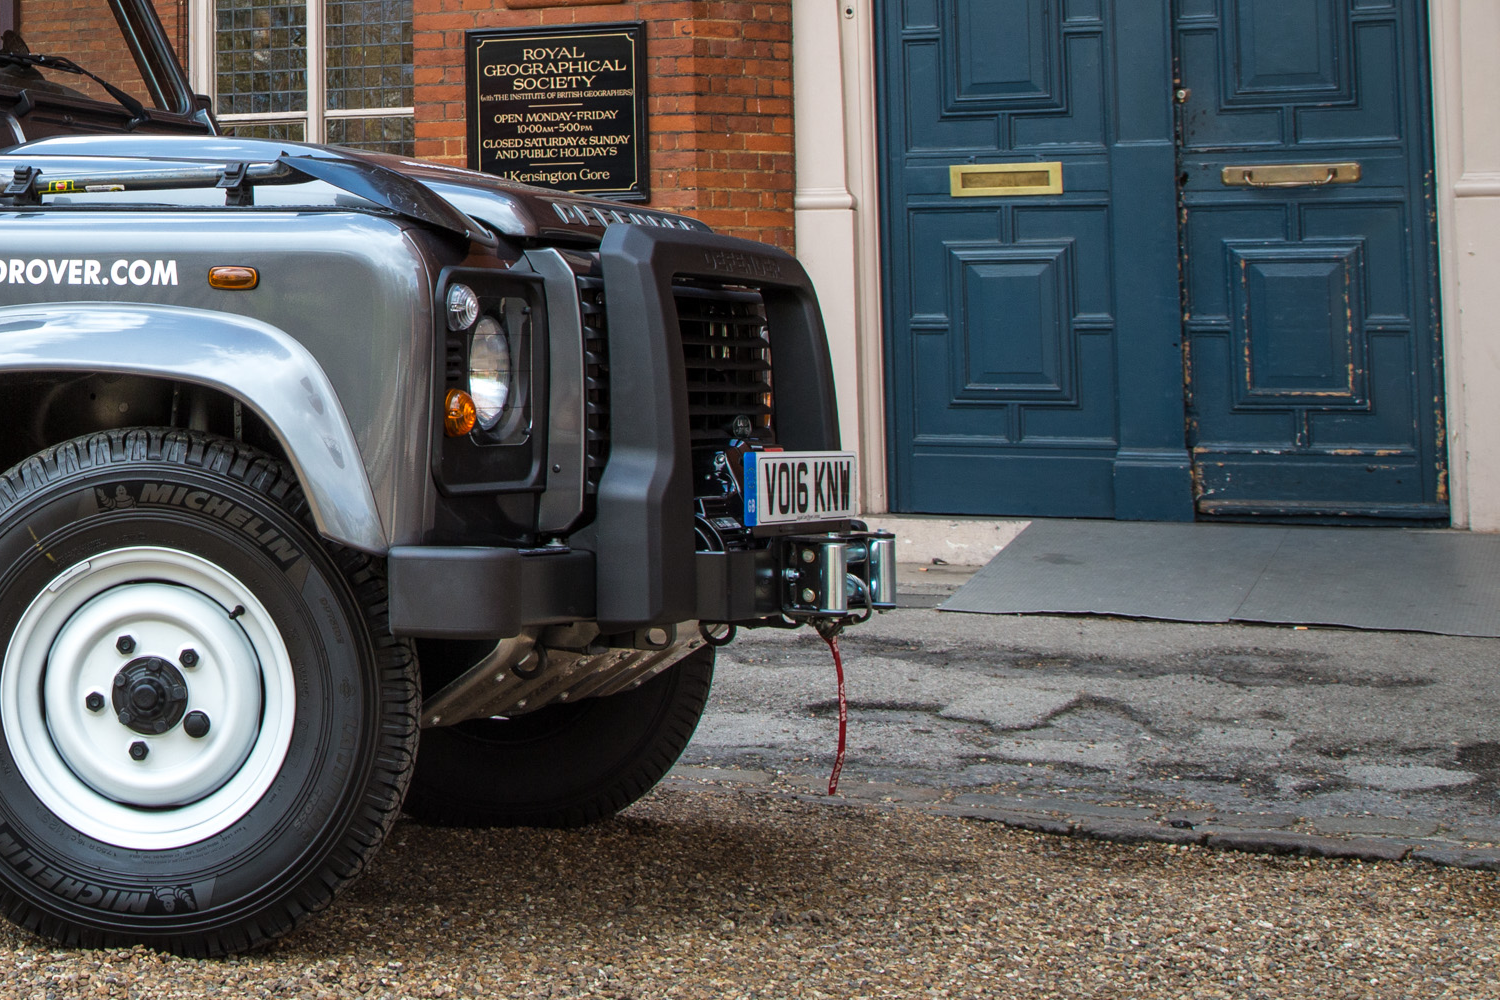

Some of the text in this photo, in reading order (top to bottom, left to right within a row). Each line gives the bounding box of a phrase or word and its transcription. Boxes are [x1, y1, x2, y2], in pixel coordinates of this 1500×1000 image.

[523, 47, 585, 61] ROYAL
[484, 60, 627, 77] GEOGRAPHICAL
[513, 75, 596, 91] SOCIETY
[510, 92, 546, 100] INSTITUTE
[556, 90, 583, 99] BRITISH
[494, 109, 619, 124] OPEN MONDAY-FRIDAY
[483, 138, 523, 148] CLOSED
[589, 134, 631, 145] SUNDAY
[495, 146, 618, 159] AND PUBLIC HOLIDAYS
[510, 169, 577, 184] Kensington
[579, 168, 610, 181] Gore
[814, 460, 851, 513] KNW
[747, 498, 756, 513] GB
[138, 483, 302, 566] MICHELIN
[0, 827, 152, 912] MICHELIN
